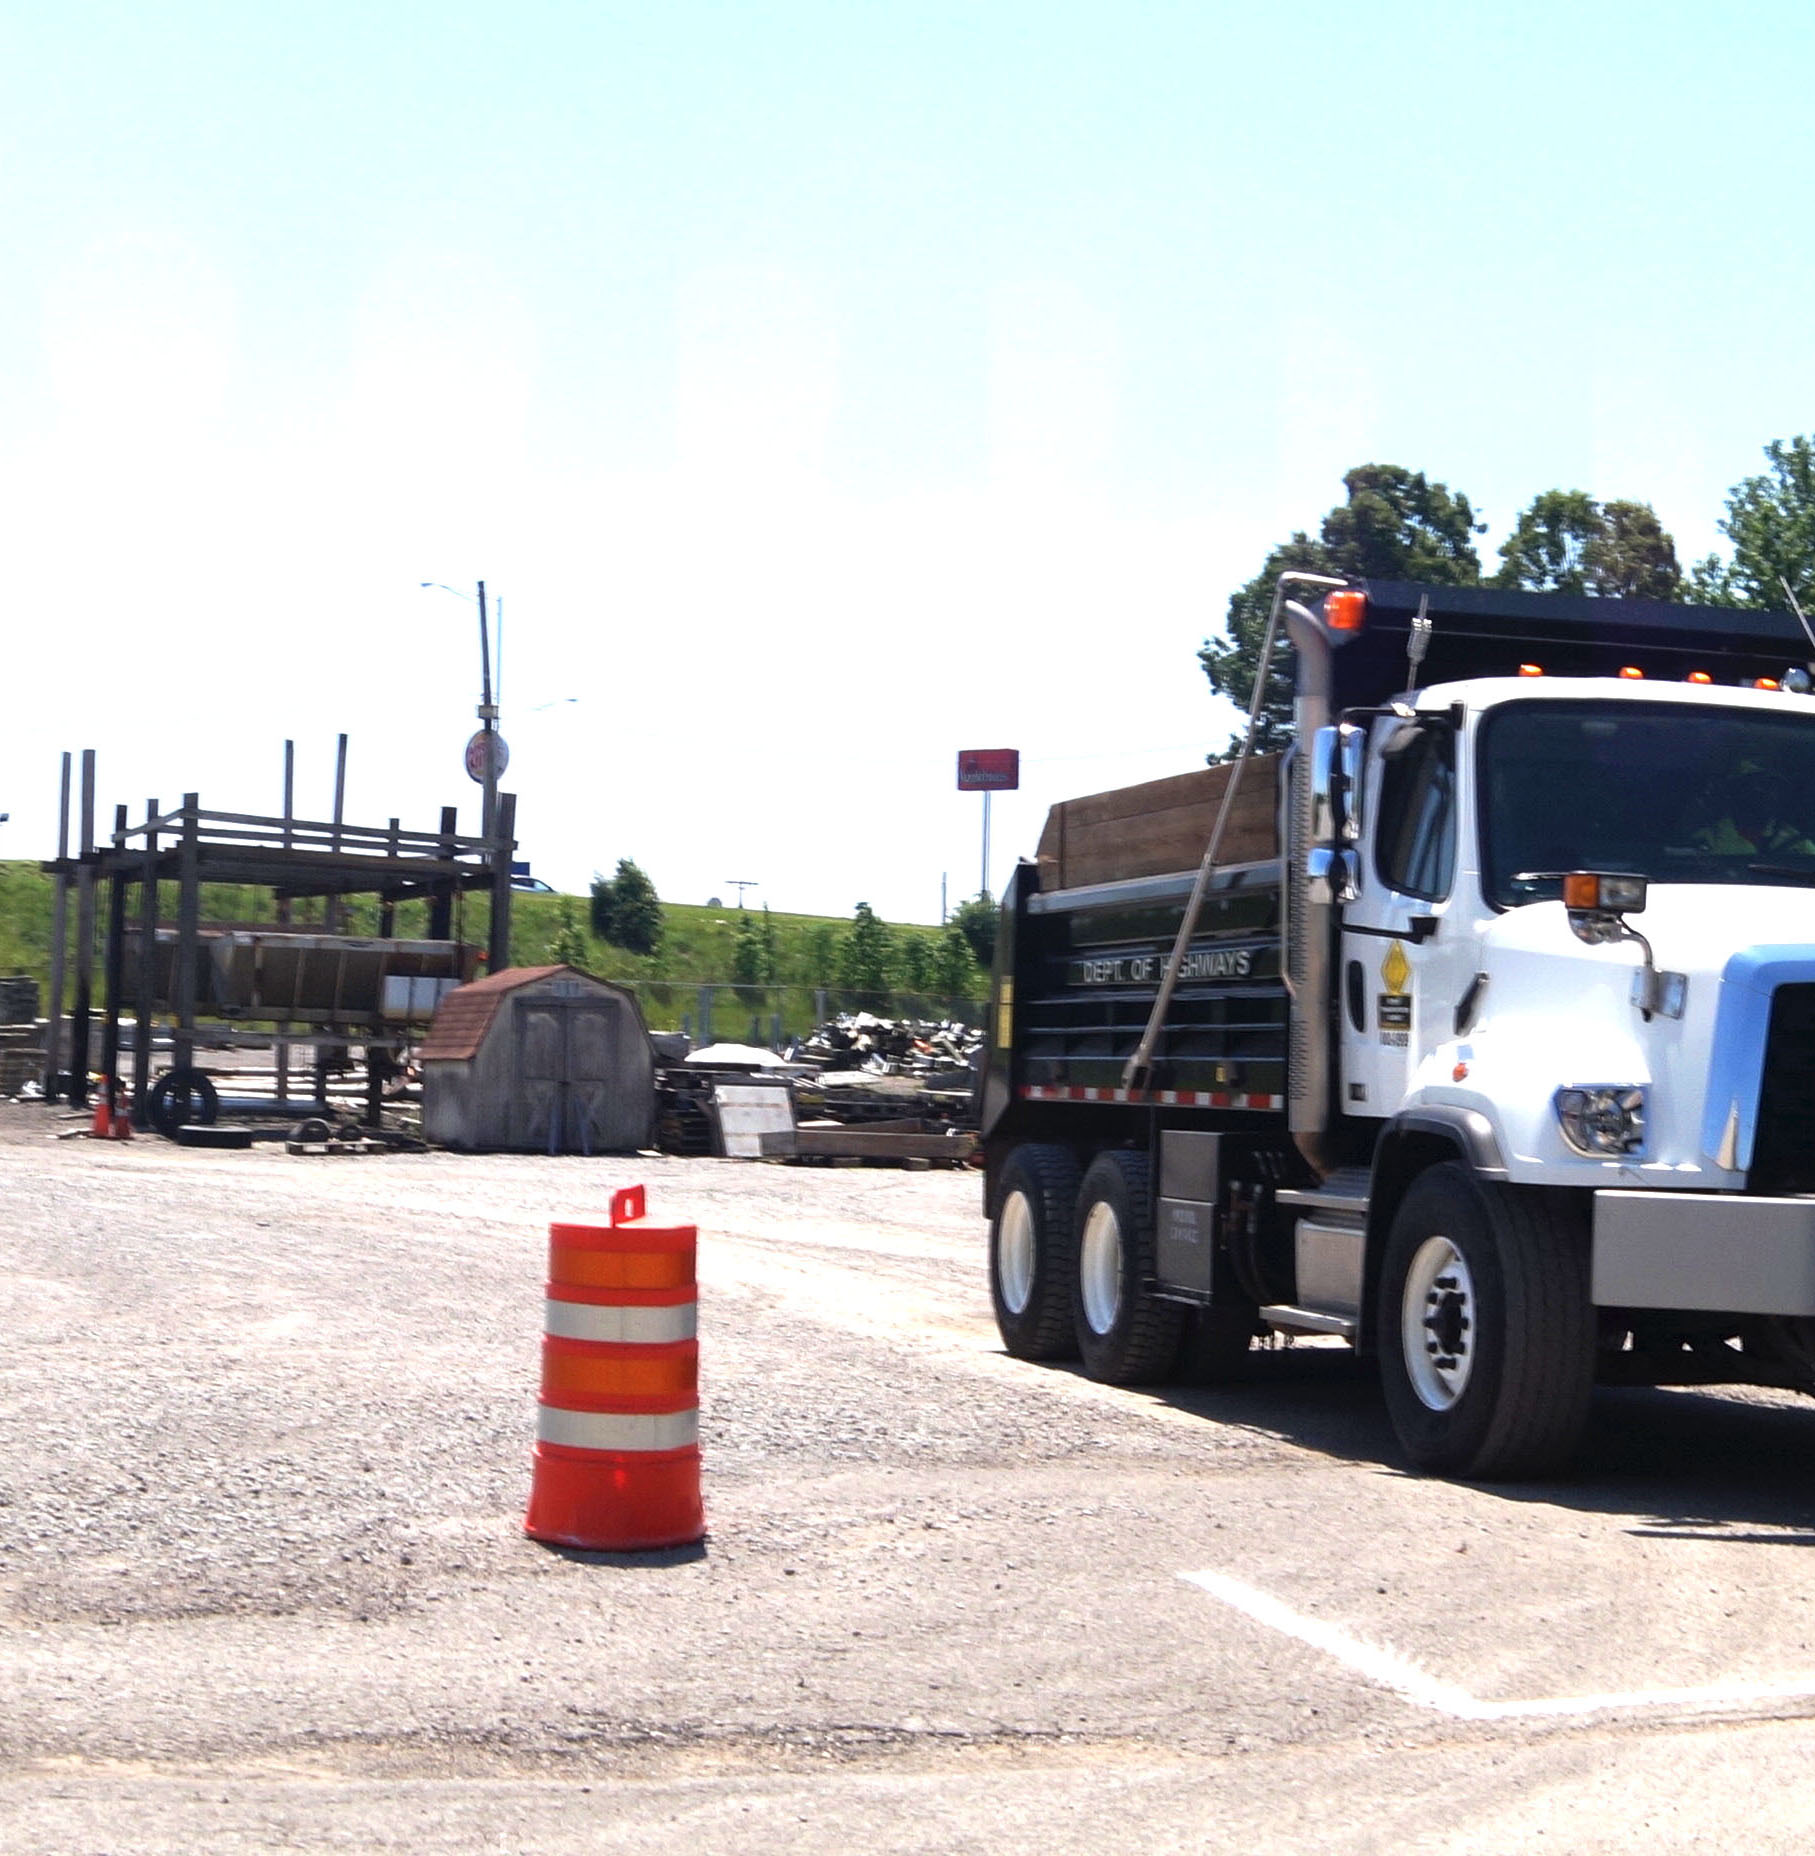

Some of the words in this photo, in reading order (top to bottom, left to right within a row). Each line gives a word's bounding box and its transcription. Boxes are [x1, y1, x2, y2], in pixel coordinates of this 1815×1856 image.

[1083, 960, 1124, 983] DEPT.
[1130, 958, 1154, 981] OF
[1160, 950, 1250, 980] HGHWAYS
